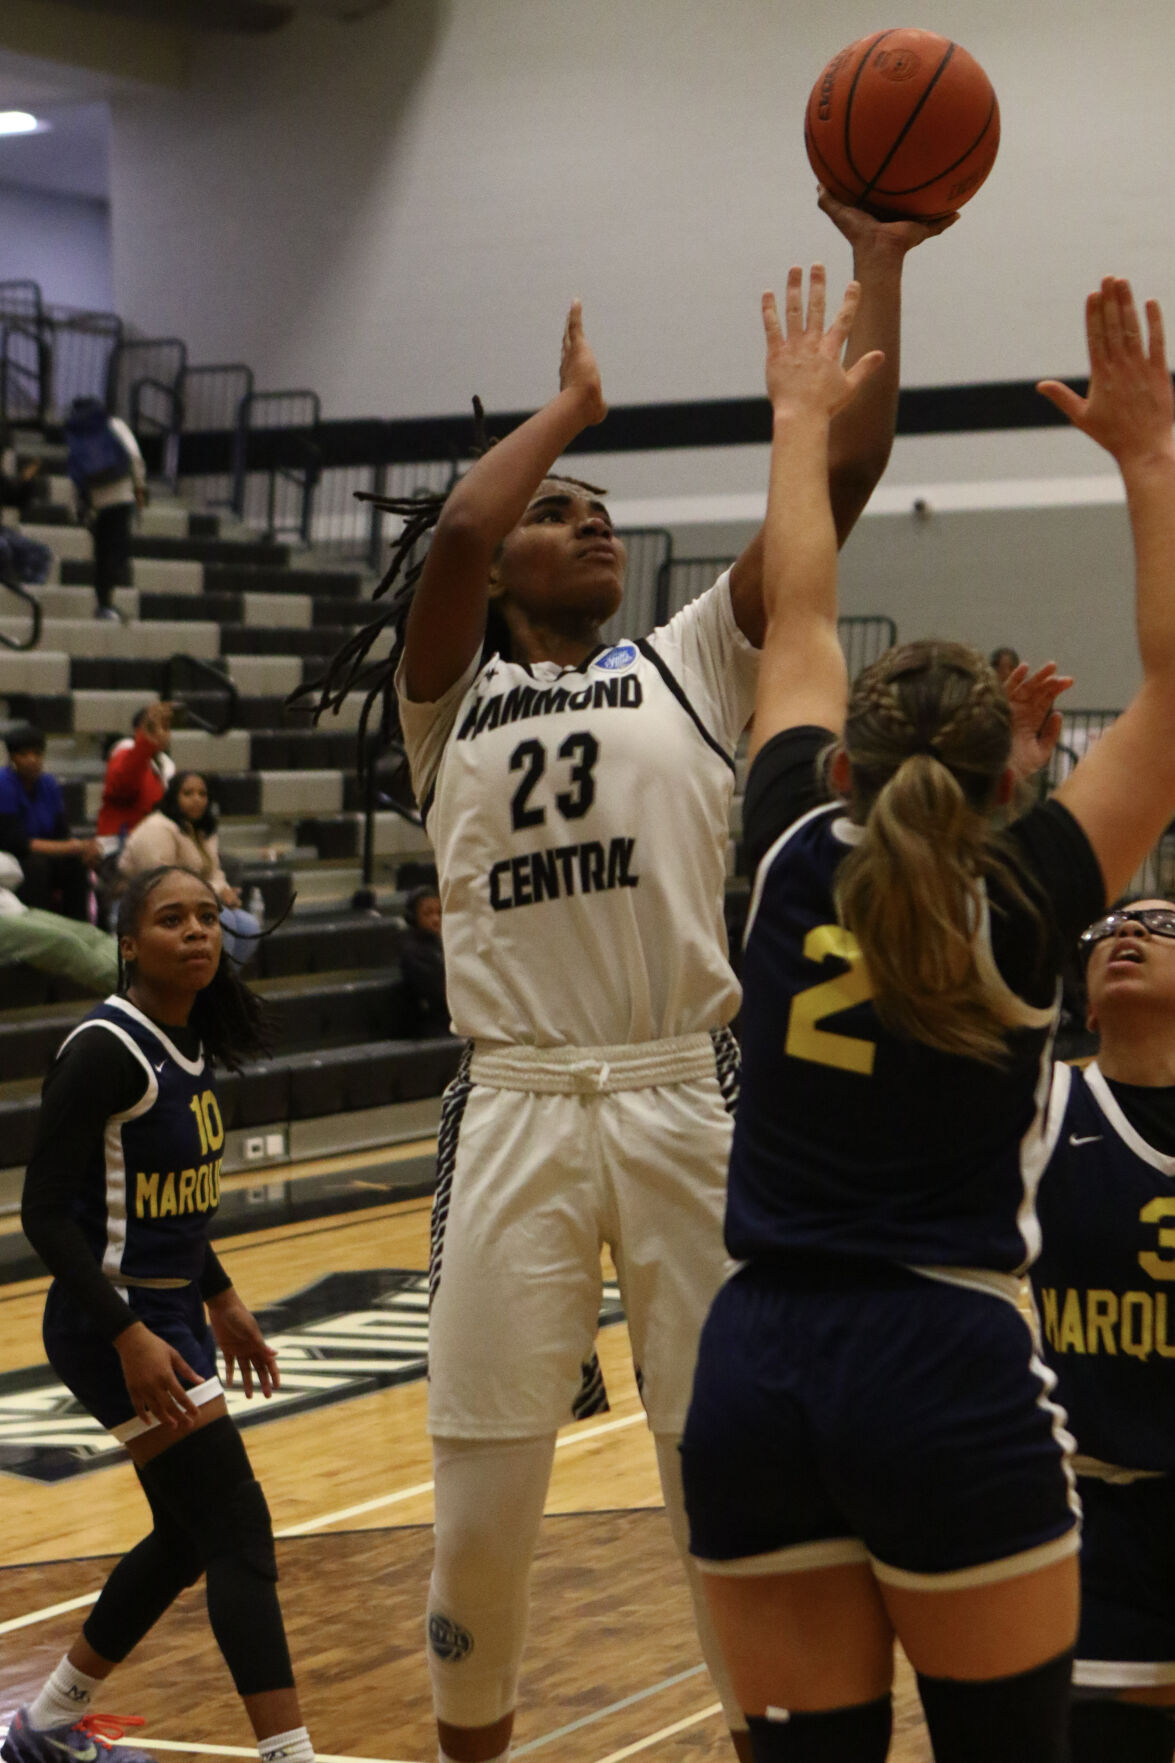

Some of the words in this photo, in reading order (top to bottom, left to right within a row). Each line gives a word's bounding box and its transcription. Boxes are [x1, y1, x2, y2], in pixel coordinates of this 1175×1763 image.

[508, 730, 600, 832] 23
[489, 836, 640, 912] CENTRAL
[784, 924, 877, 1076] 2
[189, 1089, 225, 1156] 10
